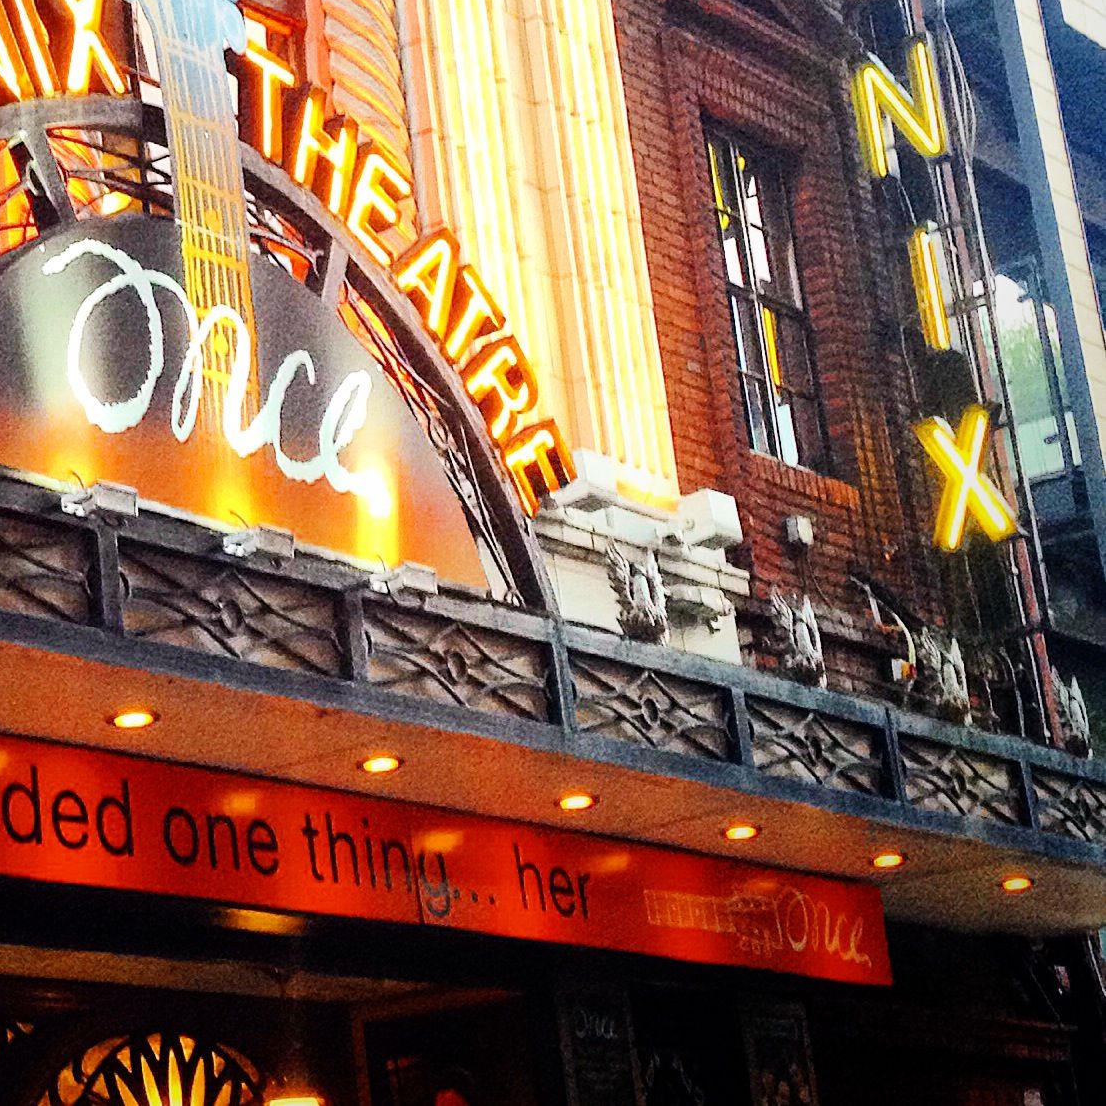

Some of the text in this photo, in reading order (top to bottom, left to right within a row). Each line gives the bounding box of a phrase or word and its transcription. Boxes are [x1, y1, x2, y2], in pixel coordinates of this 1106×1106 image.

[243, 40, 579, 518] THEATRE
[162, 803, 281, 876] one
[511, 843, 593, 921] her
